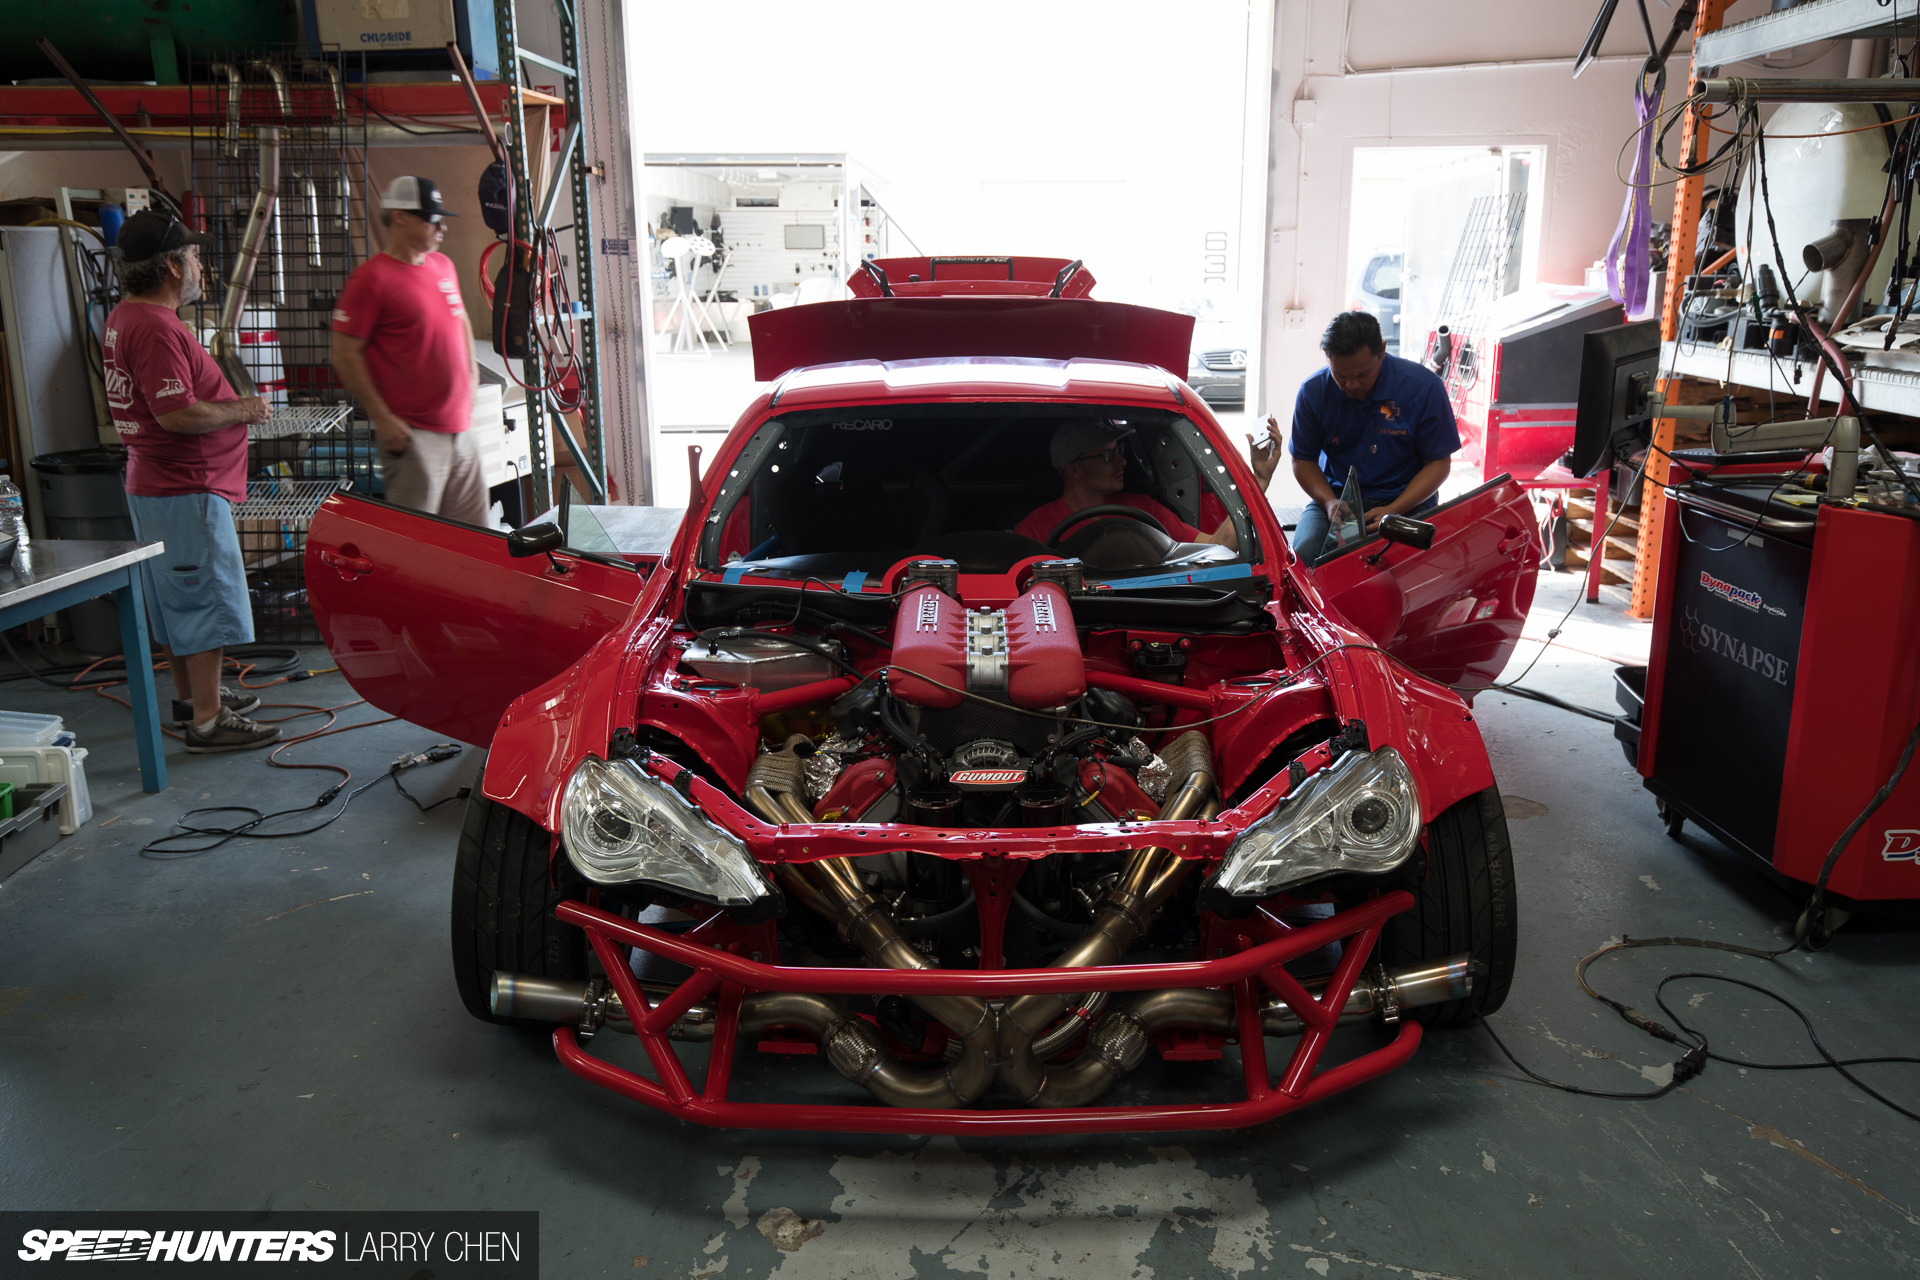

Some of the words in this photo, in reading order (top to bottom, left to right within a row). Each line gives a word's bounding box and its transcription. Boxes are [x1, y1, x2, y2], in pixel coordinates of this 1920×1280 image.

[360, 31, 411, 43] CHLORIDE
[832, 419, 893, 431] RECARO
[1700, 570, 1762, 609] Dynapack
[1699, 623, 1789, 686] SYNAPSE
[956, 772, 1023, 781] GUMOUT
